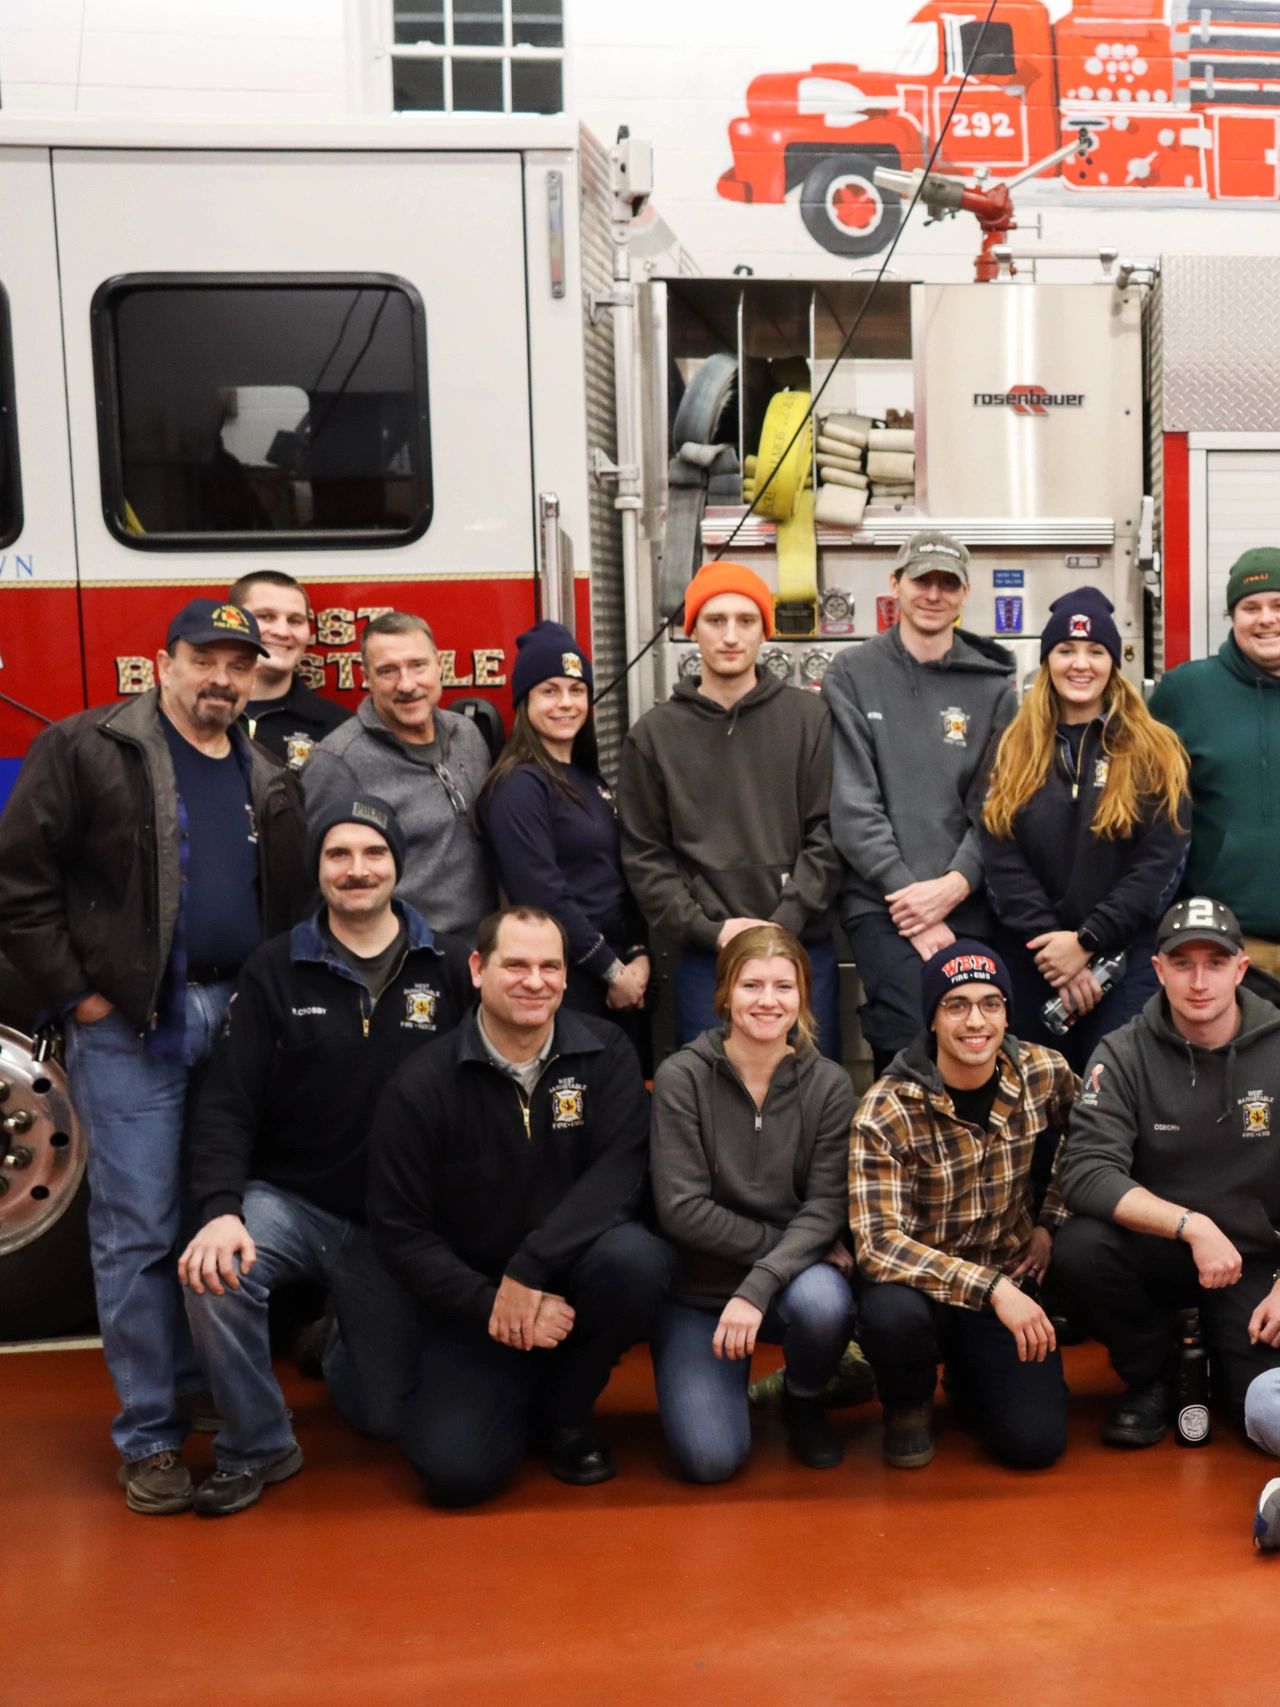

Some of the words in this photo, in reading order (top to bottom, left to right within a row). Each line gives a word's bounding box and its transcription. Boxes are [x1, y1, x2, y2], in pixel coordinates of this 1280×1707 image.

[951, 111, 1016, 138] 292
[973, 388, 1085, 406] rosenbauer
[1189, 898, 1213, 926] 2
